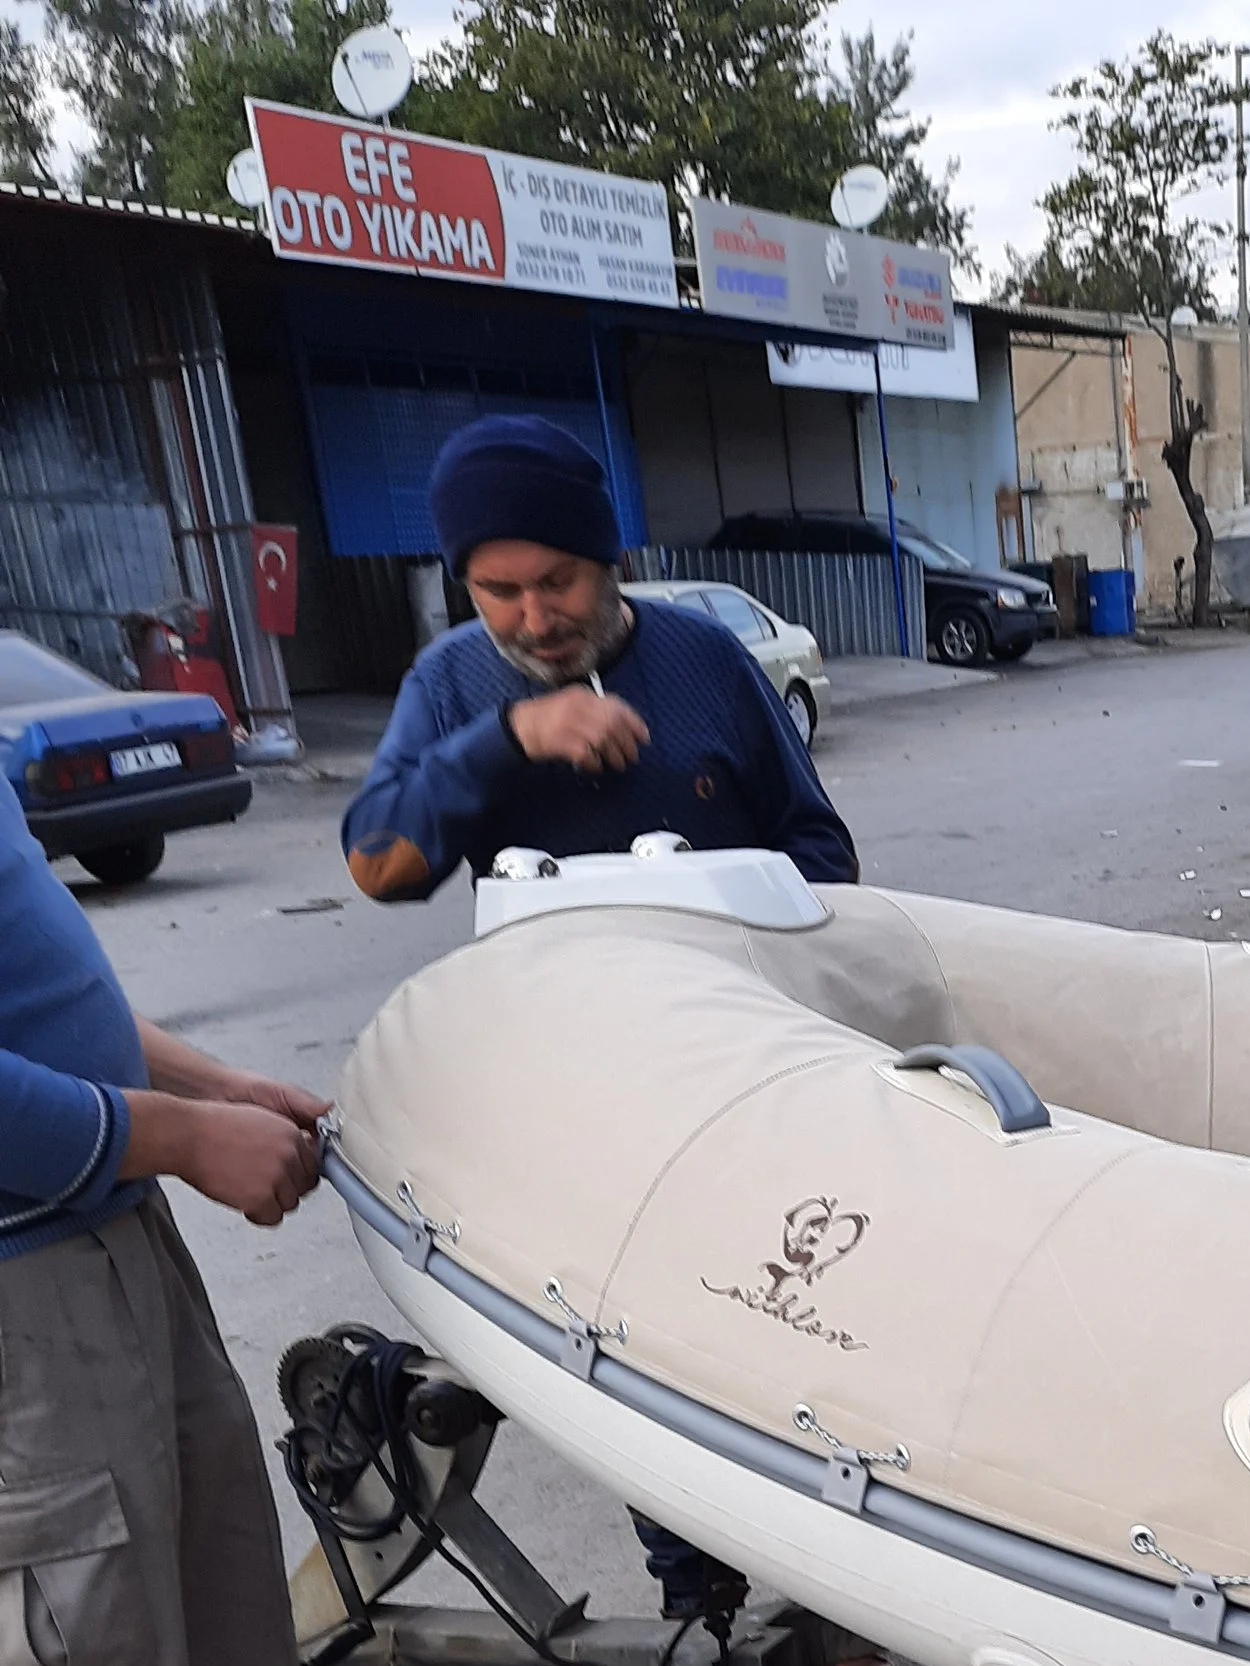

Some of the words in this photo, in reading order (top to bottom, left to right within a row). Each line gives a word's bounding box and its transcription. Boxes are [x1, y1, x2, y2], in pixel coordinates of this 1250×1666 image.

[341, 131, 416, 203] EFE
[501, 160, 518, 198] İÇ
[526, 172, 551, 204] DIŞ
[553, 176, 608, 211] DETAYLI
[609, 186, 666, 221] TEMİZLİK
[271, 185, 352, 251] OTO
[356, 199, 496, 271] YIKAMA
[540, 208, 568, 238] OTO
[571, 214, 602, 243] ALIM
[604, 219, 643, 248] SATIM
